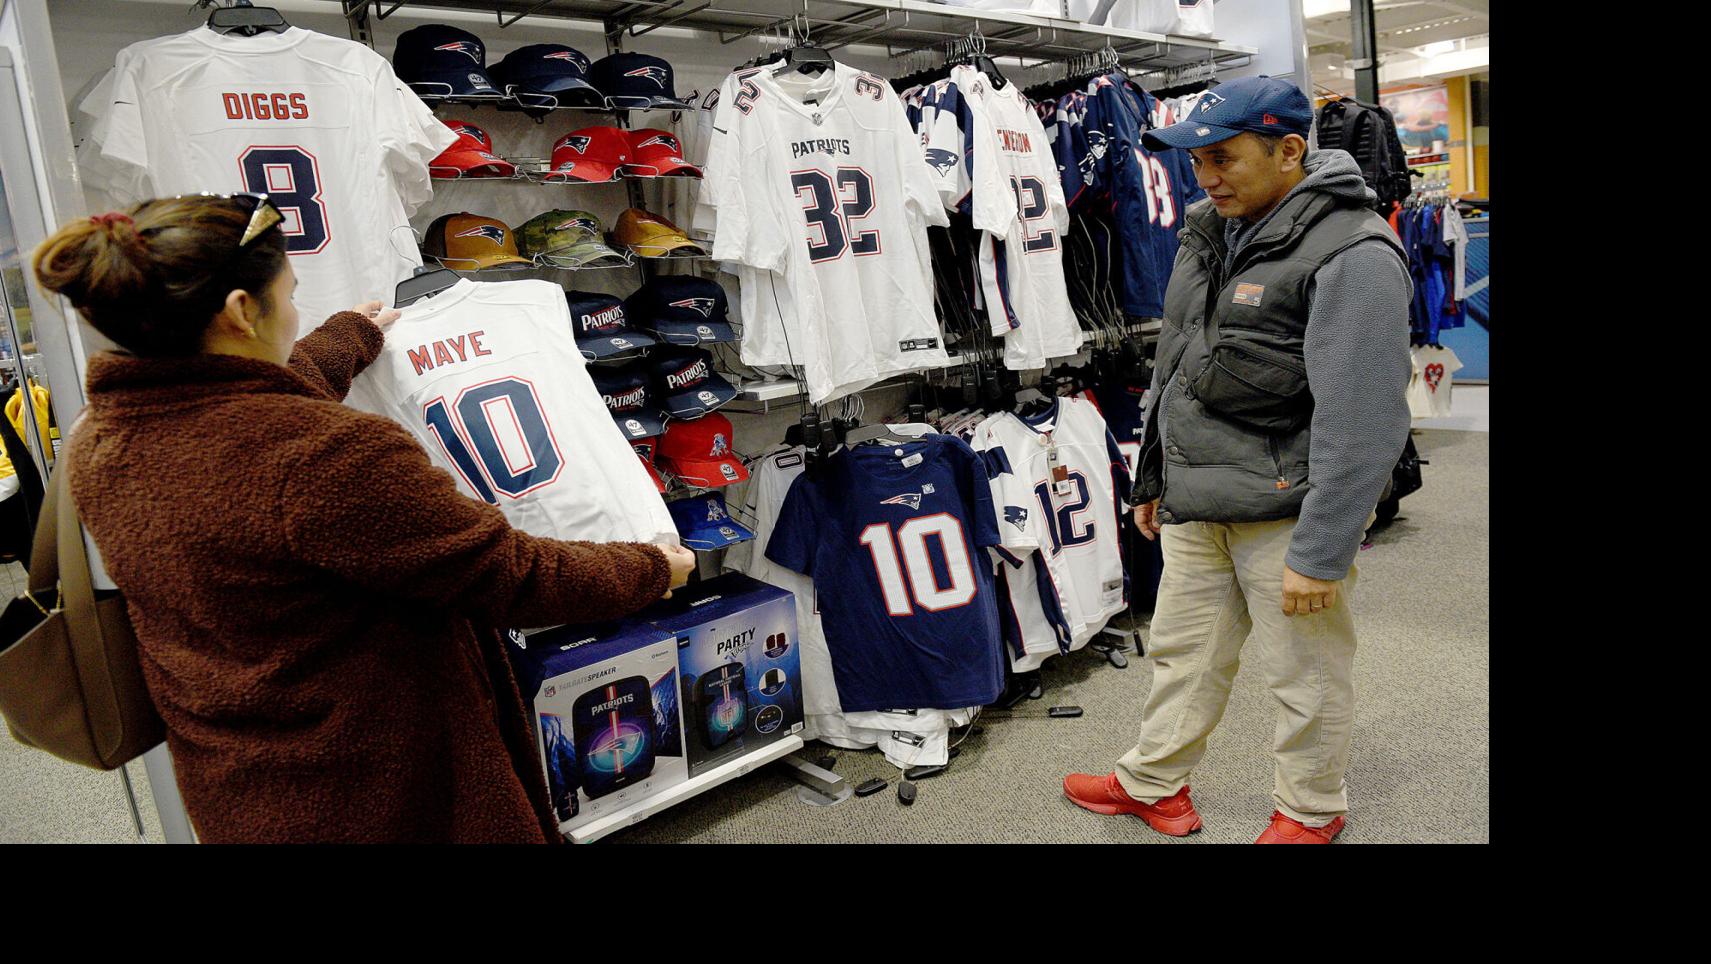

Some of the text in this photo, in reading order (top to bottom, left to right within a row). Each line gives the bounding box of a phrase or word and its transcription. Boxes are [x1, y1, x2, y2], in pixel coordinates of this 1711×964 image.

[222, 92, 309, 120] DIGGS
[791, 138, 851, 159] PATRIOTS
[238, 145, 331, 255] 8
[789, 165, 882, 263] 32
[581, 305, 624, 331] PATRIOTS
[406, 330, 492, 376] MAYE
[666, 358, 707, 389] PATRIOTS
[602, 386, 645, 410] PATRIOTS
[422, 375, 566, 507] 10
[1034, 469, 1097, 560] 12
[858, 511, 978, 618] 10
[560, 636, 598, 651] SOAR
[717, 627, 756, 655] PARTY
[591, 693, 634, 716] PATRIOTS
